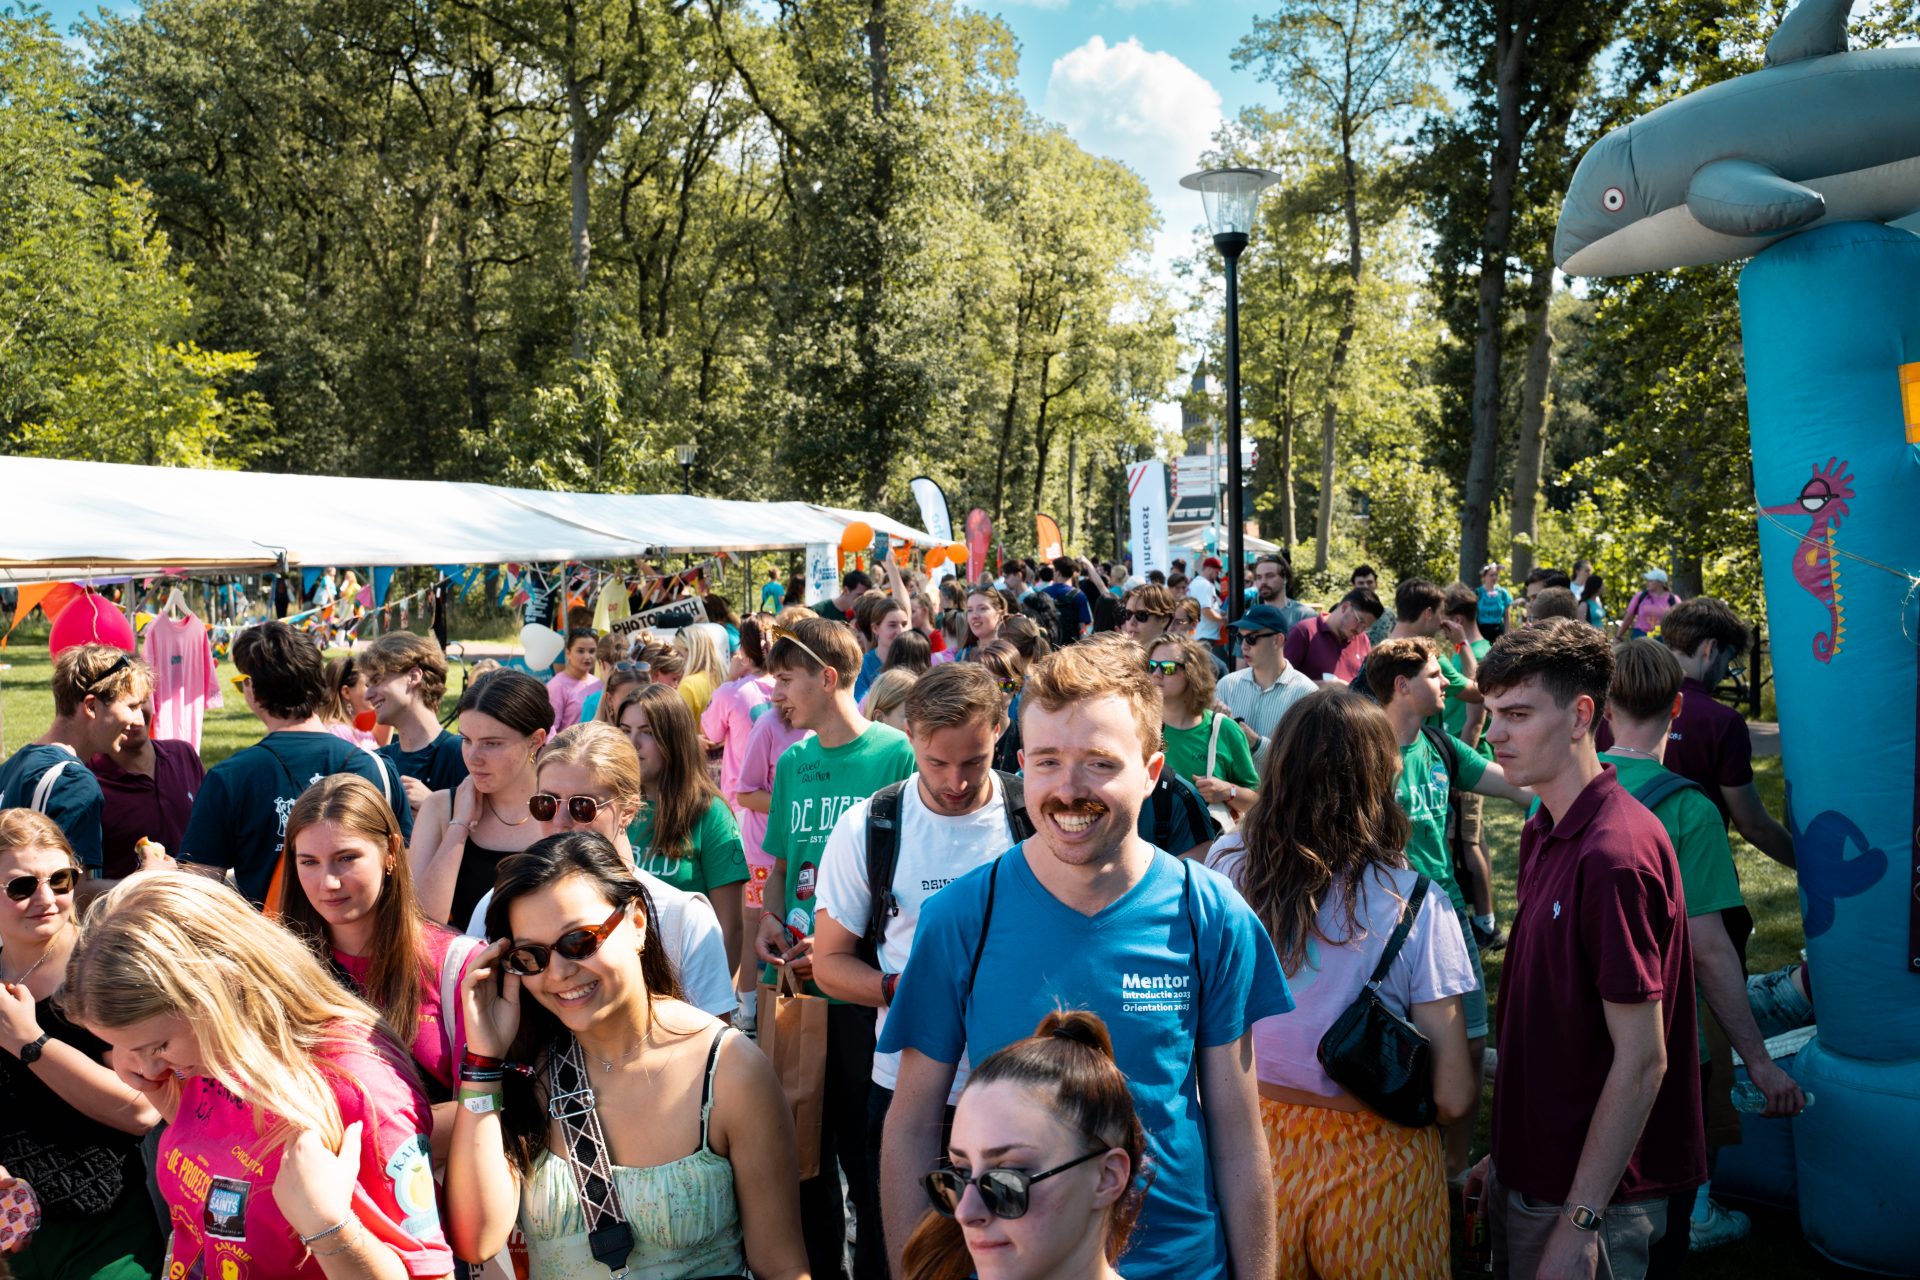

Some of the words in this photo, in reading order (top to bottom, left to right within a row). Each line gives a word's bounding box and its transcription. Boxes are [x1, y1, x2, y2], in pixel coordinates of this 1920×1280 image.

[612, 601, 700, 634] PHOTOOTH
[791, 798, 813, 834] DE
[1122, 973, 1189, 989] Mentor
[1123, 991, 1172, 999] Introductie
[1173, 991, 1191, 999] 2023
[1123, 1003, 1173, 1012] Orientation
[1174, 1003, 1190, 1012] 2023
[209, 1198, 238, 1213] SAINTS
